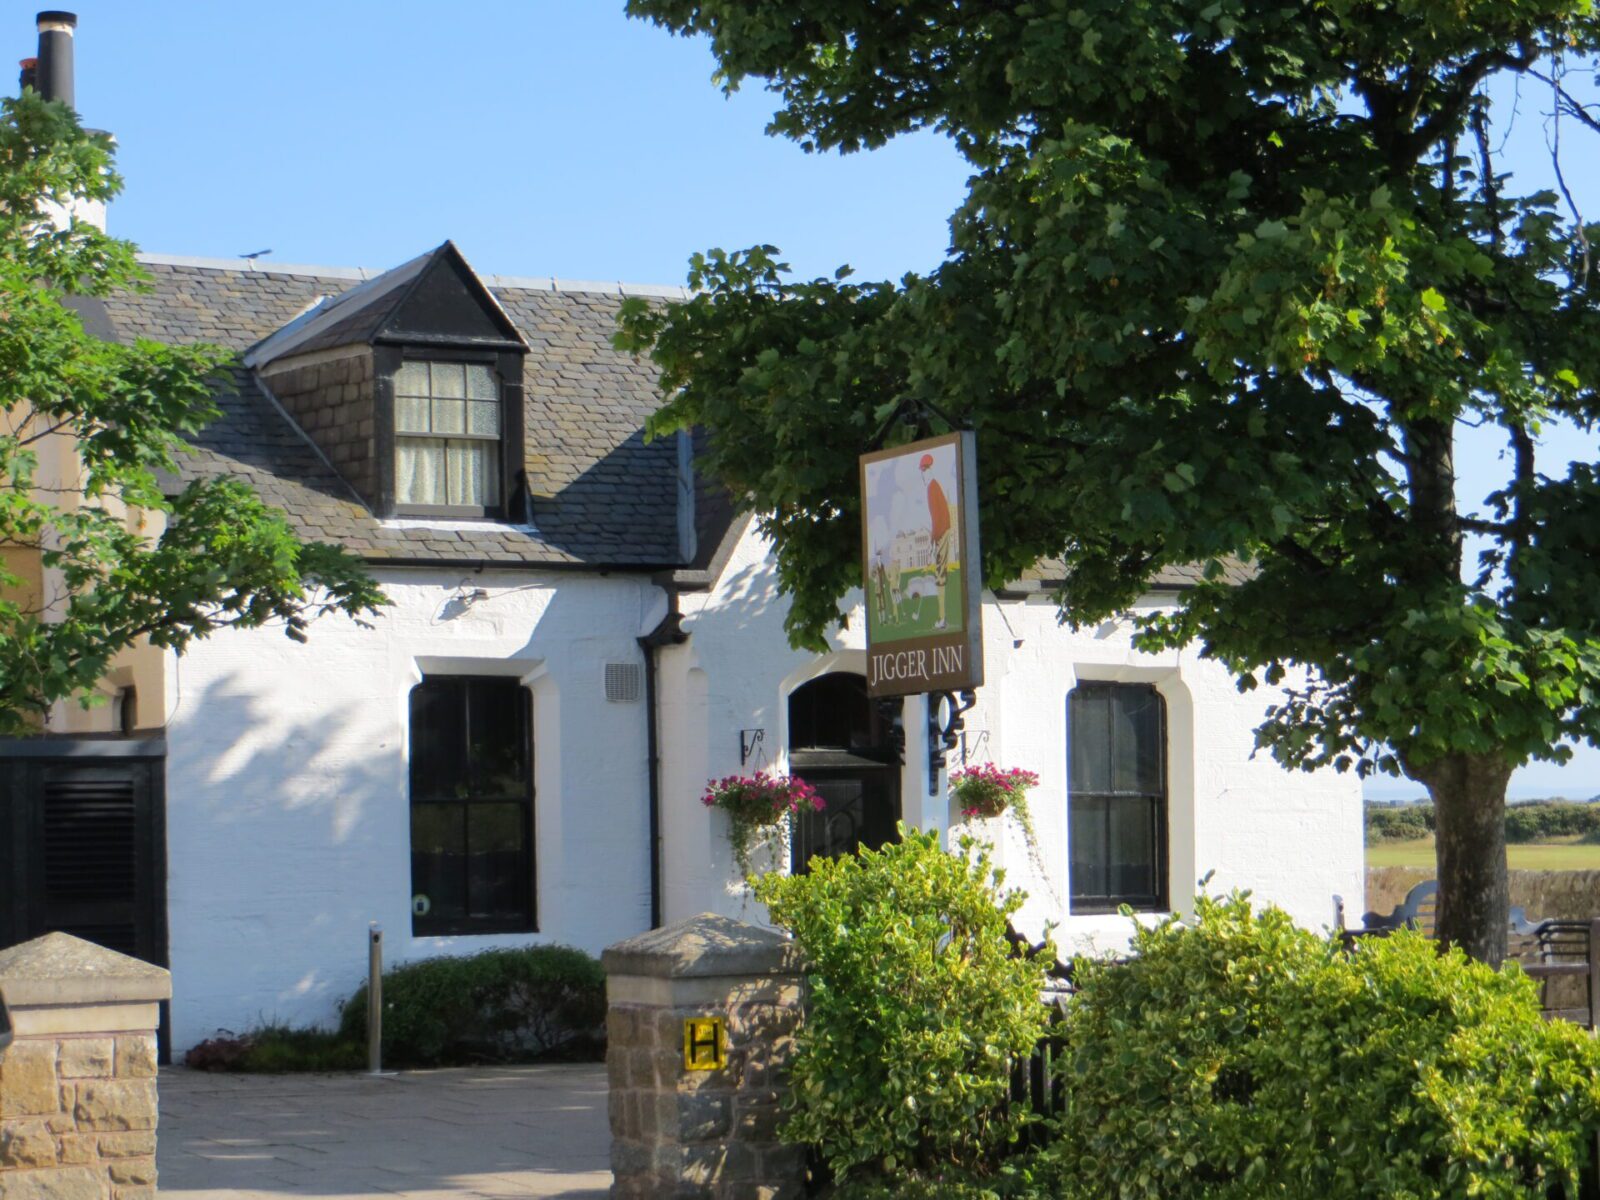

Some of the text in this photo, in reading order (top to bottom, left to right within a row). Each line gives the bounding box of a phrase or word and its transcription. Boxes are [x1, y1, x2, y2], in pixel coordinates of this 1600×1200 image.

[871, 645, 962, 686] JIGGER INN
[690, 1023, 719, 1064] H
